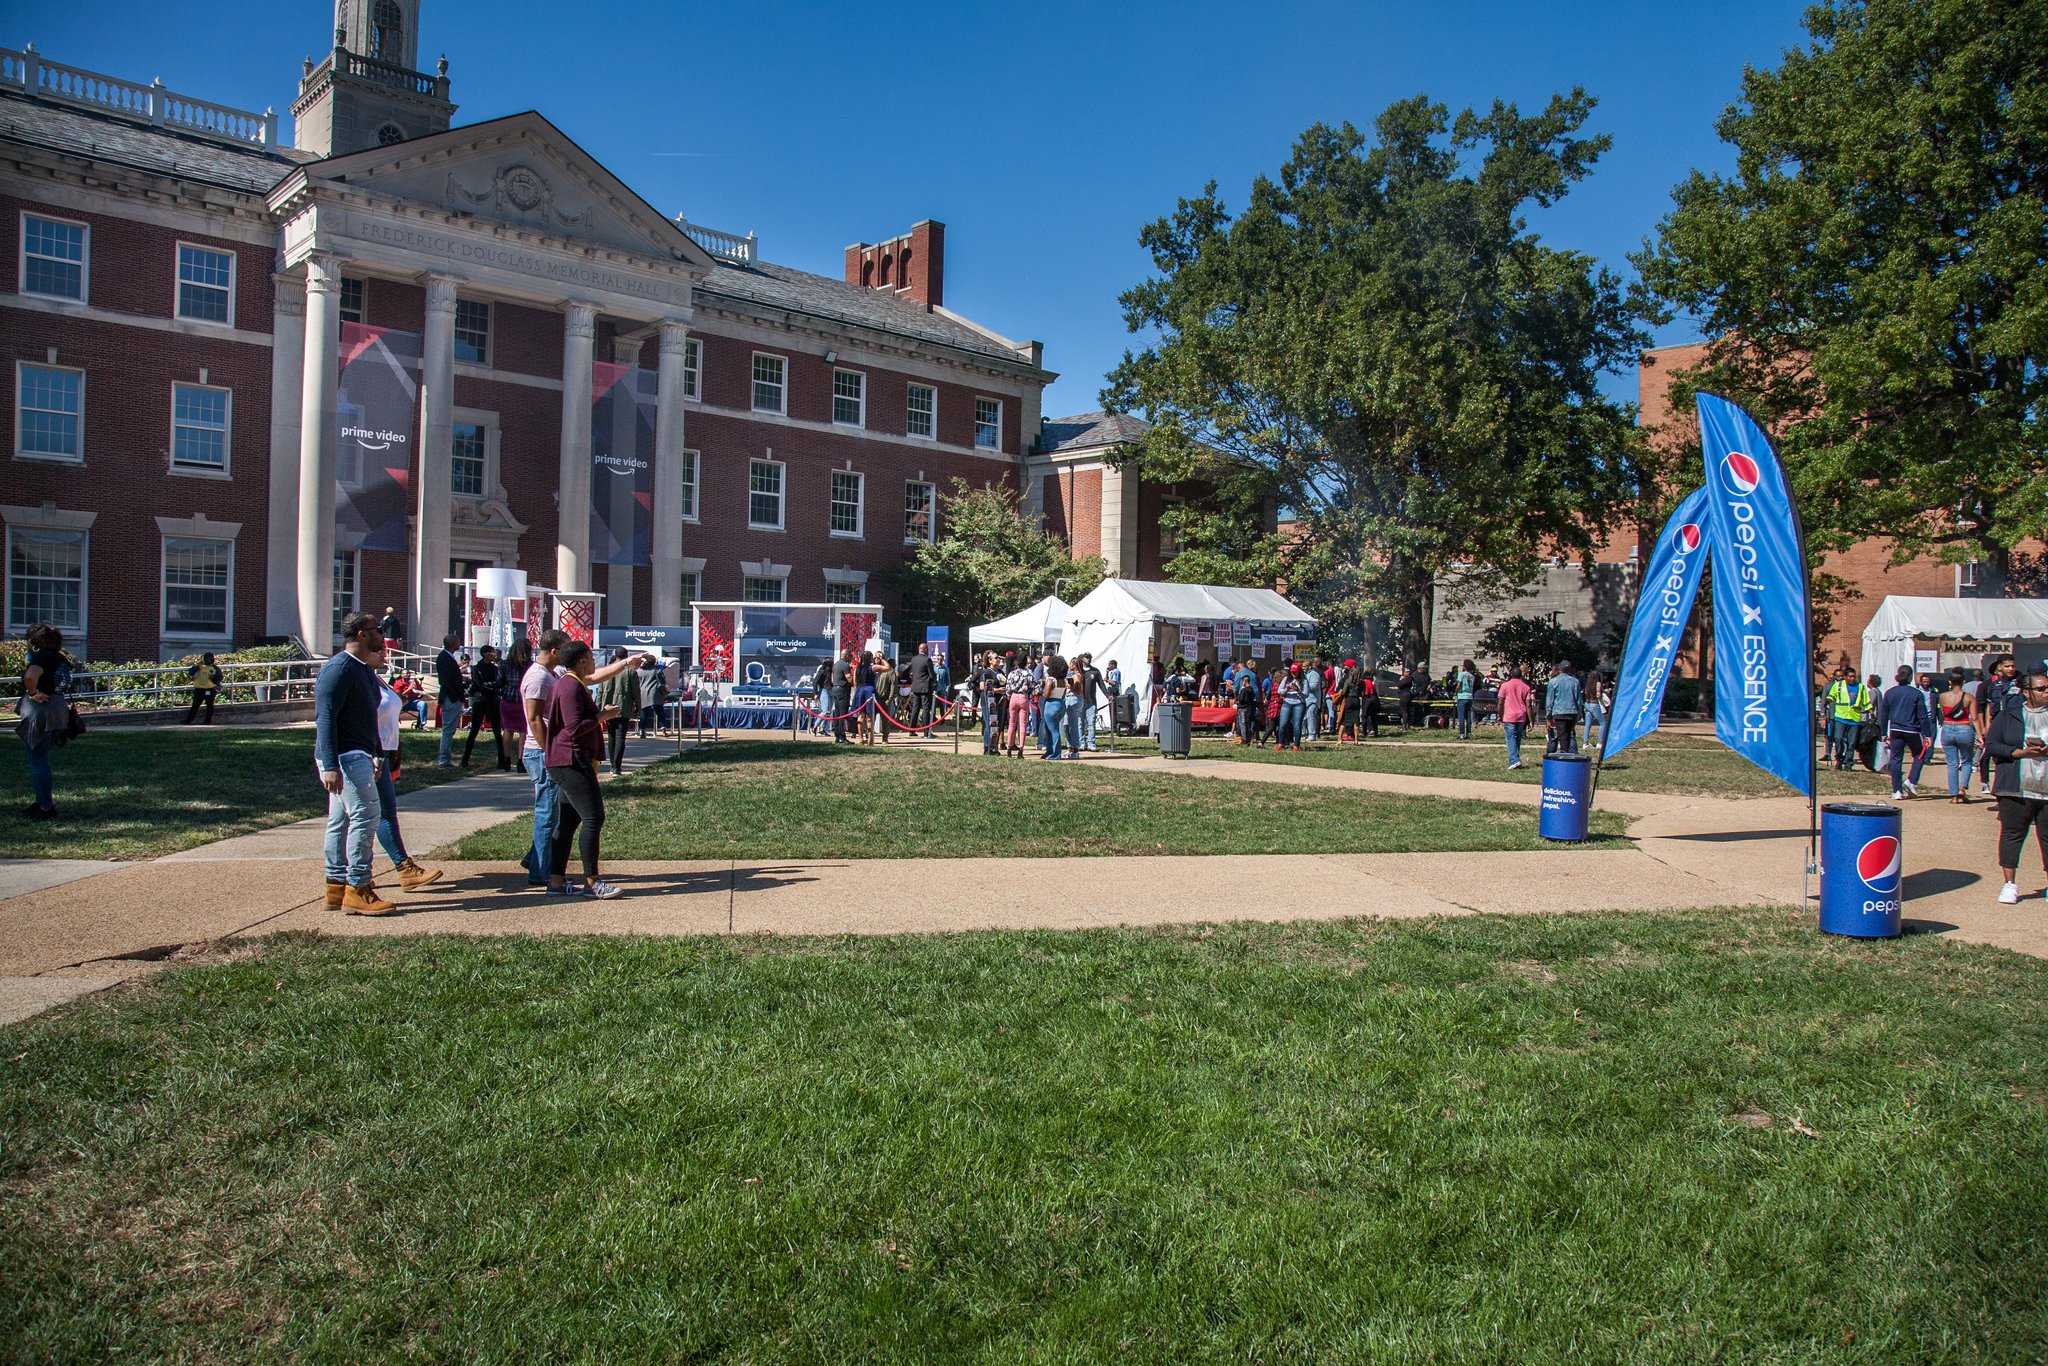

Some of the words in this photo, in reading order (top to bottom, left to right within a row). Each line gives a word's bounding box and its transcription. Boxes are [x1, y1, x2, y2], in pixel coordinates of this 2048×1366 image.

[361, 222, 455, 254] FREDERICK
[462, 244, 542, 271] DOUGLASS
[547, 262, 623, 288] MEMORIAL
[626, 280, 660, 296] HALL
[341, 426, 374, 440] prime
[375, 430, 406, 443] video
[594, 453, 622, 466] prime
[623, 457, 648, 469] video
[1728, 501, 1765, 593] pepsi
[1661, 558, 1687, 627] pepsi
[625, 630, 646, 638] prime
[766, 639, 787, 648] prime
[1945, 643, 1988, 653] JAMROCK
[1989, 643, 2011, 653] JERK
[1633, 656, 1668, 730] ESSENCE
[1743, 634, 1767, 743] ESSENCE
[1543, 787, 1572, 796] delicious.
[1543, 795, 1577, 805] refreshing.
